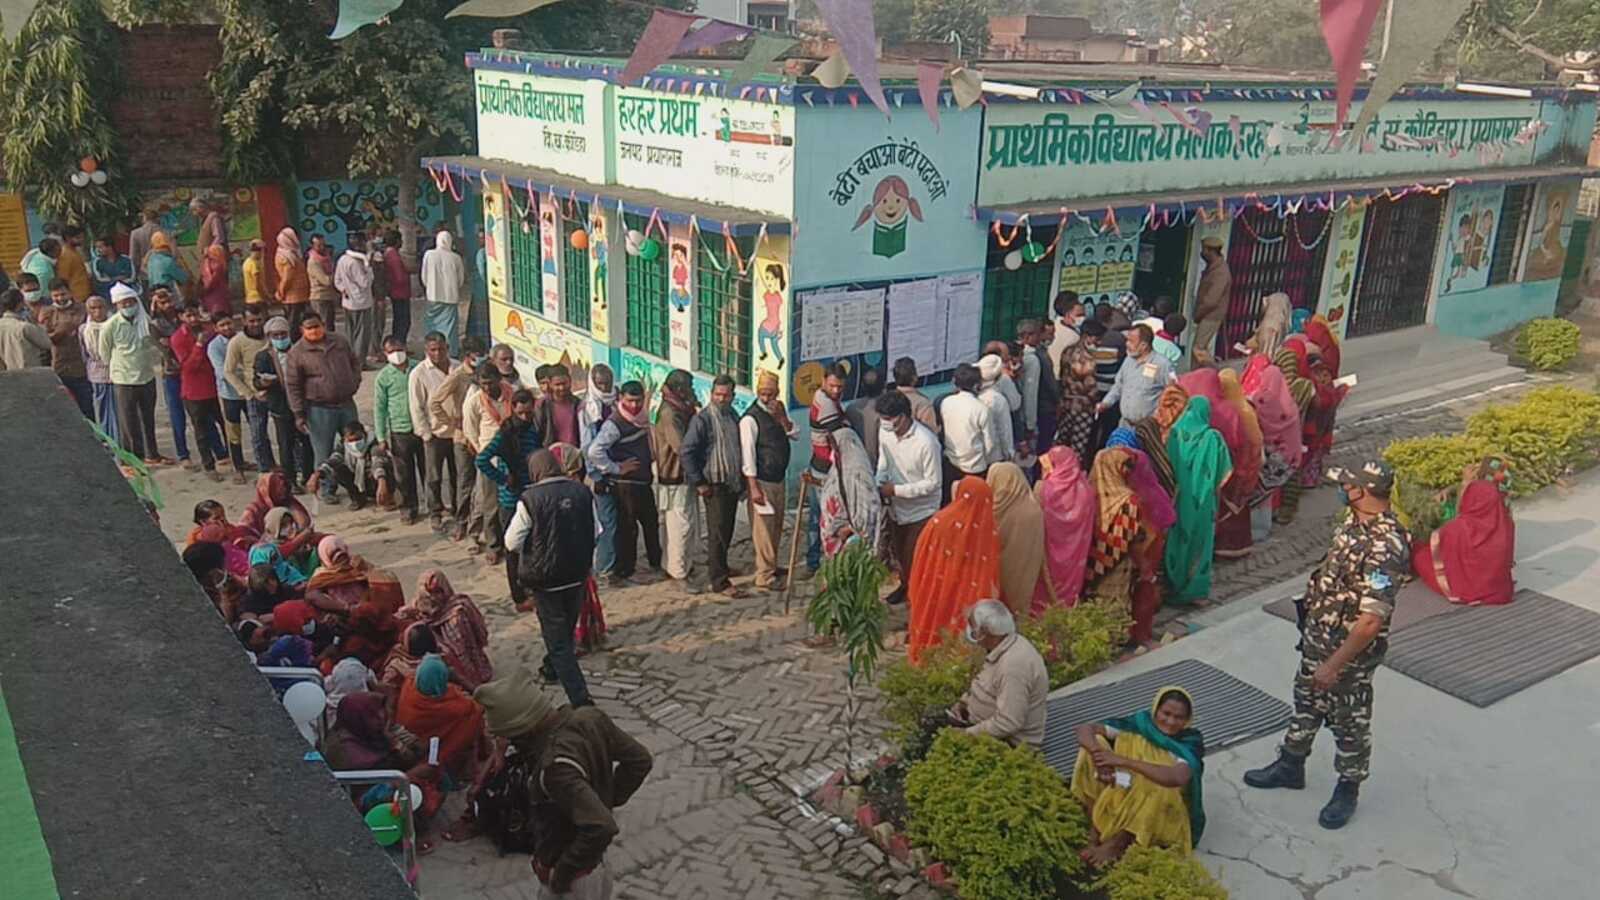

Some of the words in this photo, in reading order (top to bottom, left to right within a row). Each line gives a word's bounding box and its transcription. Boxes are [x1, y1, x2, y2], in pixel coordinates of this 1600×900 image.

[658, 98, 700, 137] प्रथम
[986, 112, 1090, 171] प्राथमिक
[1089, 112, 1172, 165] विद्यालय
[828, 167, 860, 206] बेटी
[853, 136, 897, 175] बचाओ
[898, 137, 920, 170] बेटी
